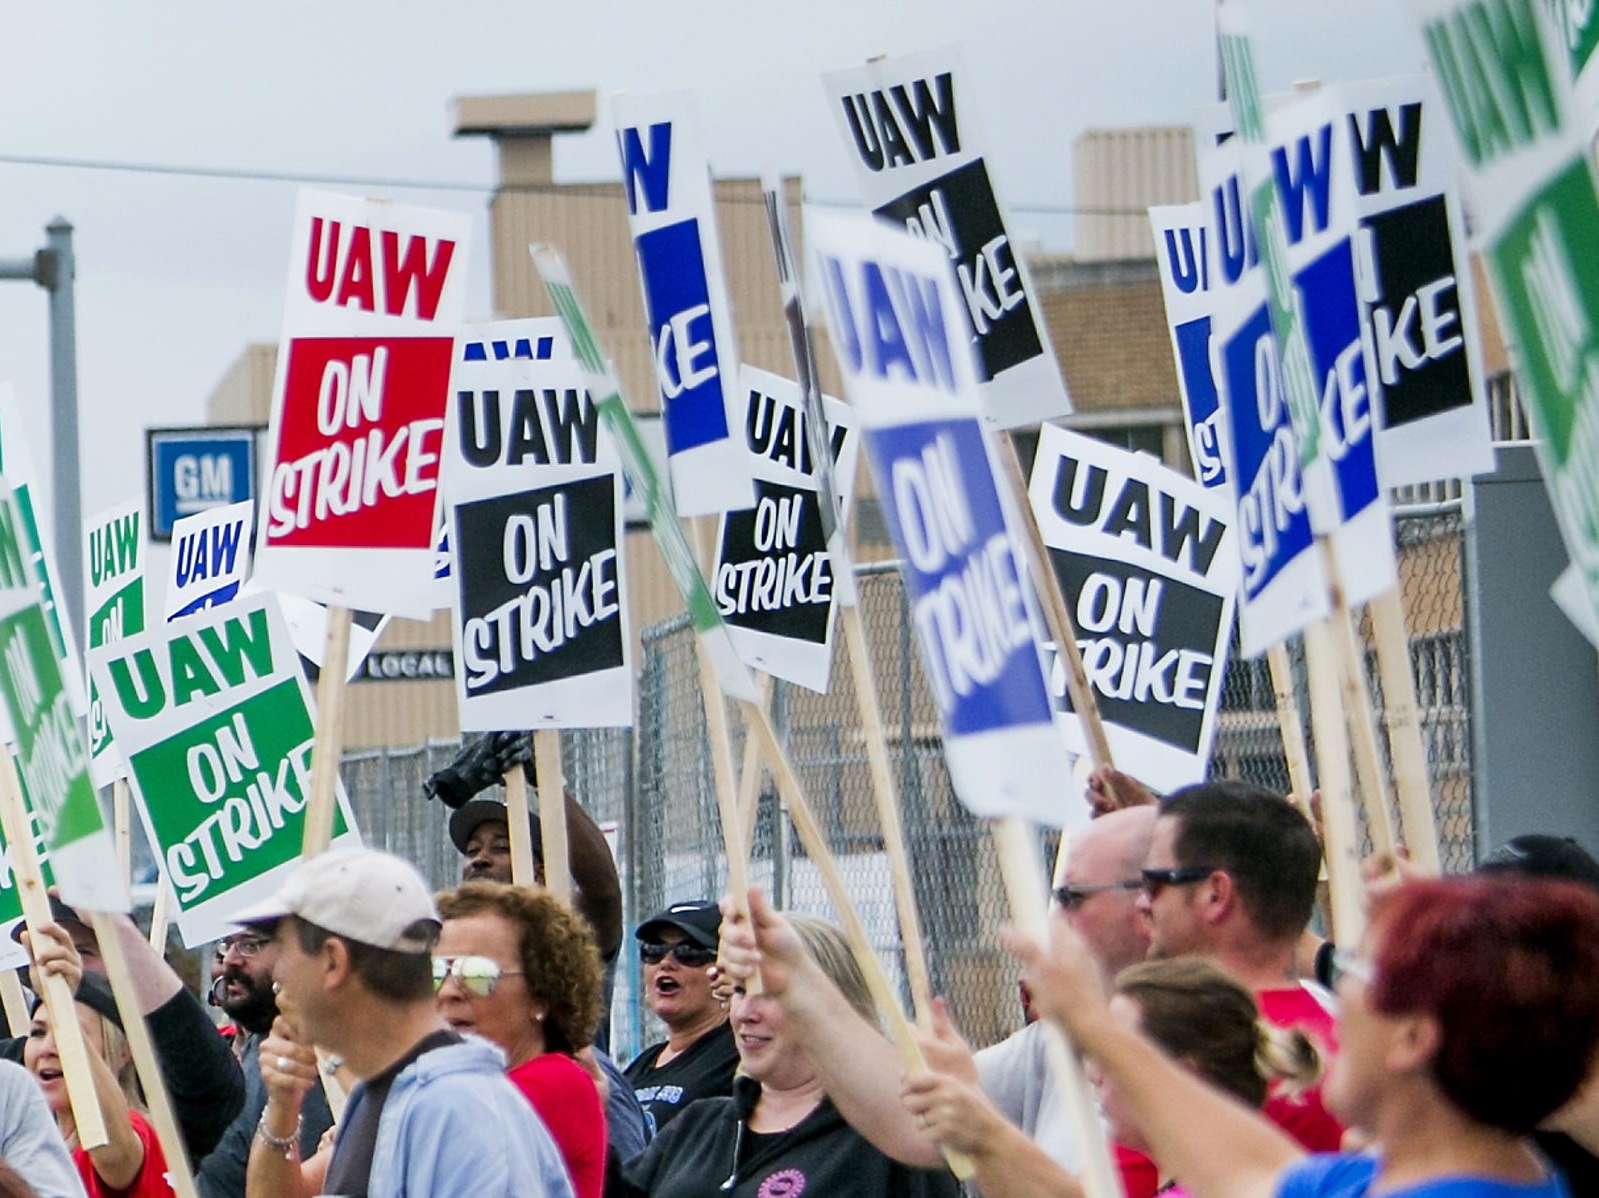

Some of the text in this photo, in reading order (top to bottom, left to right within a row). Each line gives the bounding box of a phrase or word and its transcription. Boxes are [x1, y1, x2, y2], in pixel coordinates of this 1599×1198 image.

[841, 72, 961, 172] UAW
[1213, 123, 1332, 285] UW
[306, 217, 455, 320] UAW
[317, 346, 389, 436] ON
[457, 389, 599, 468] UAW
[174, 453, 231, 499] GM
[267, 417, 444, 538] STRIKE
[892, 432, 975, 573] ON
[1052, 454, 1226, 577] UAW
[89, 511, 139, 587] UAW
[176, 520, 243, 589] UAW
[503, 493, 569, 584] ON
[755, 494, 803, 552] ON
[463, 549, 619, 689] STRIKE
[716, 551, 832, 616] STRIKE
[1077, 572, 1161, 636] ON
[108, 608, 274, 719] UAW
[368, 653, 452, 678] LOCAL
[1043, 638, 1213, 709] TRIKE
[186, 711, 259, 803] ON
